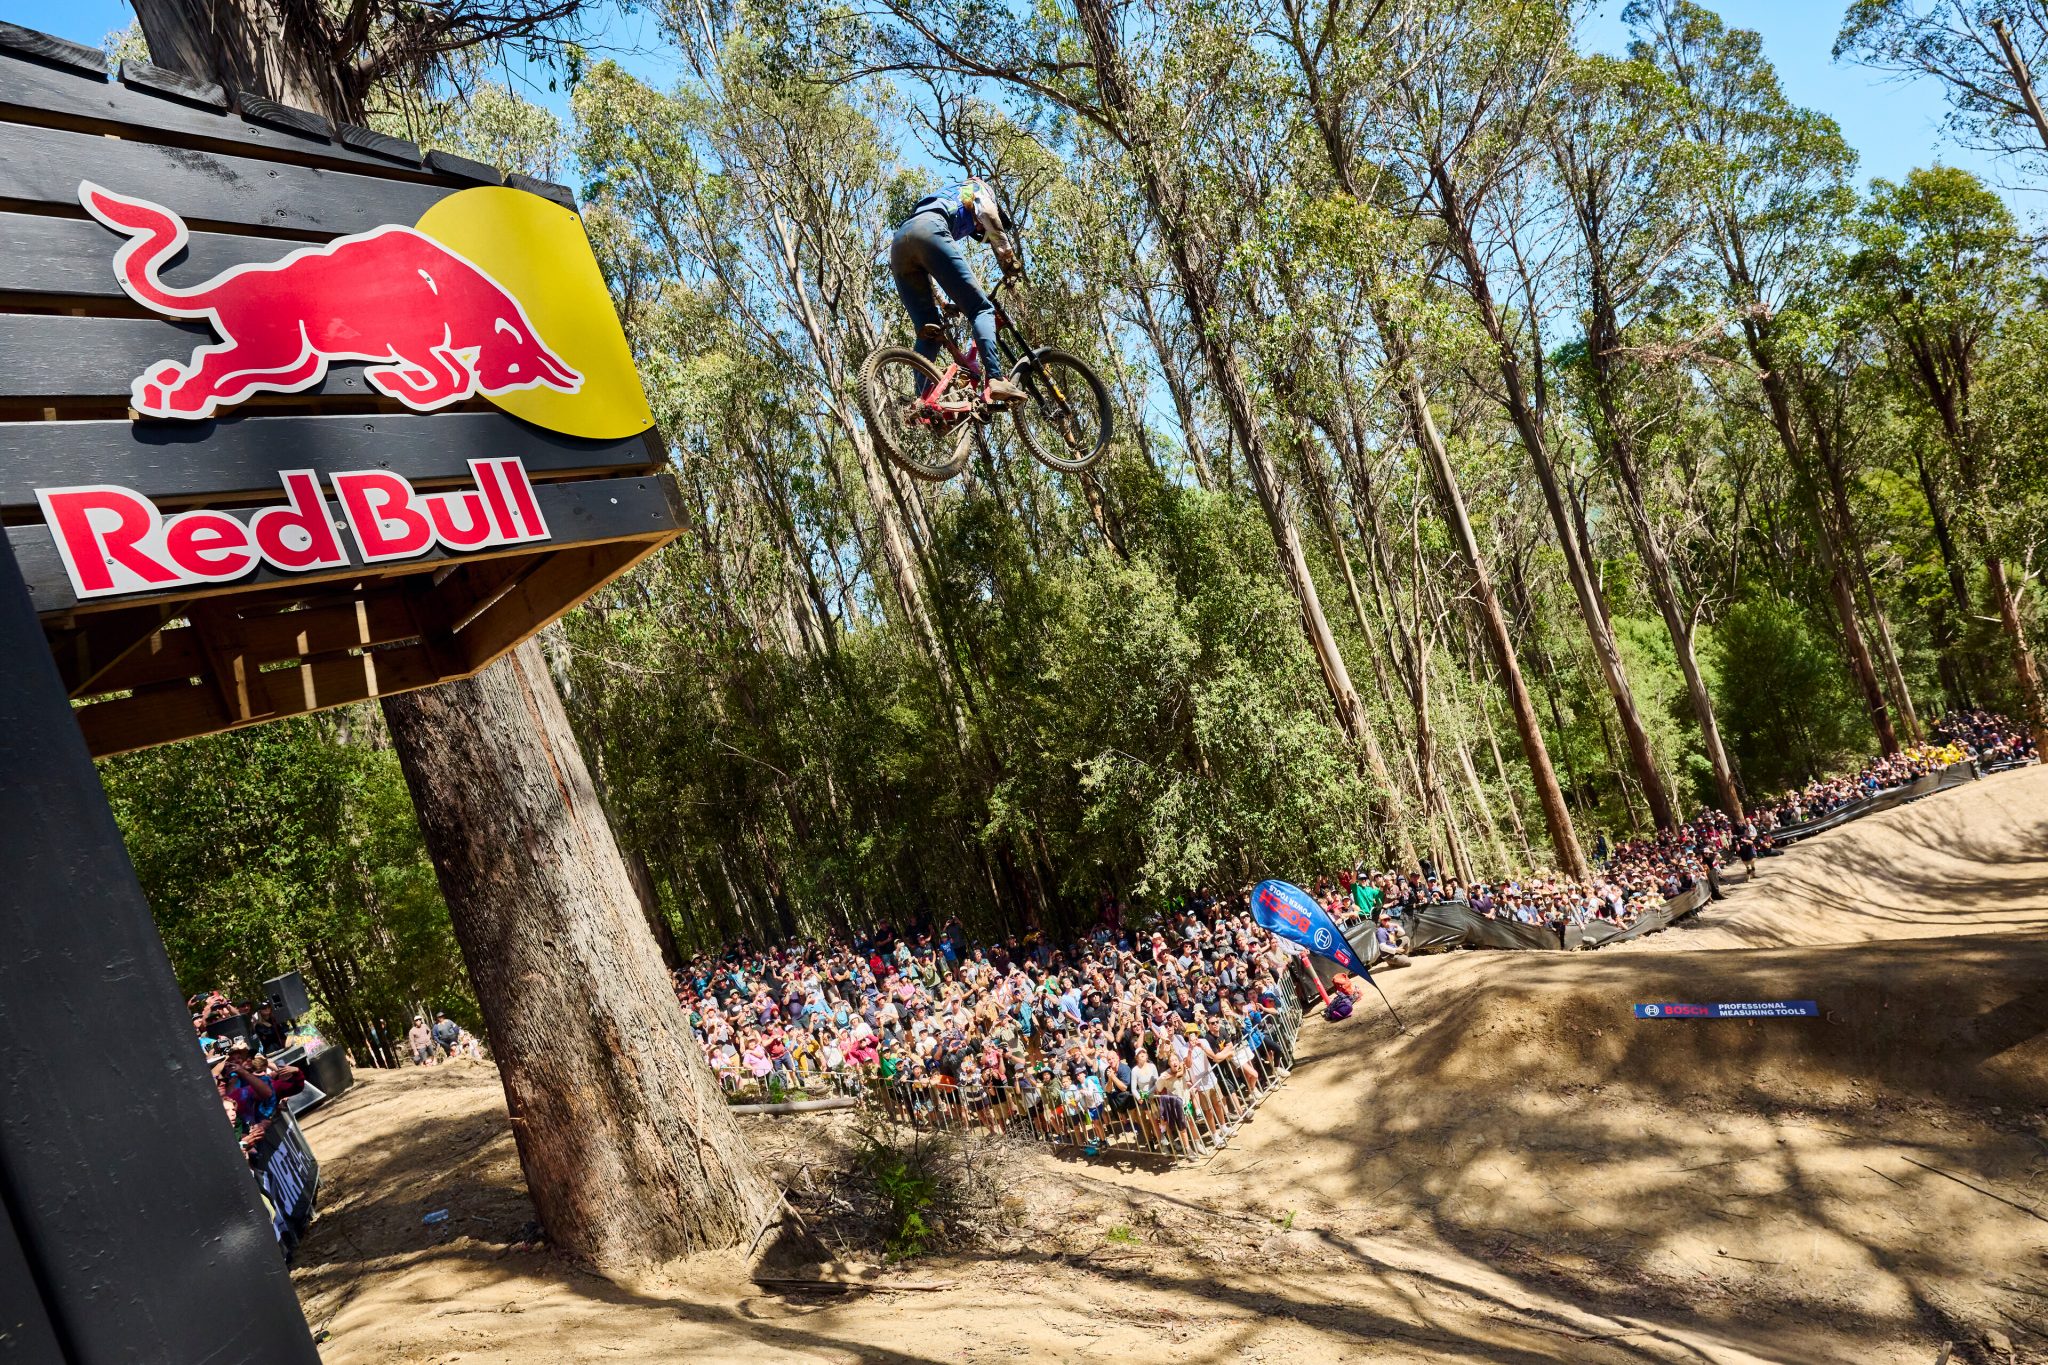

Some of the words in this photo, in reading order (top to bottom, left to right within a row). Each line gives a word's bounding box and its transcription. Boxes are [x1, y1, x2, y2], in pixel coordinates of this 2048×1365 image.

[48, 474, 341, 591] Red
[341, 462, 543, 558] Bull
[1269, 885, 1289, 901] TOOLS
[1259, 888, 1311, 934] BOSCH
[1288, 899, 1312, 919] POWER
[1664, 1005, 1709, 1015] BOSCH
[1776, 1008, 1806, 1016] TOOLS
